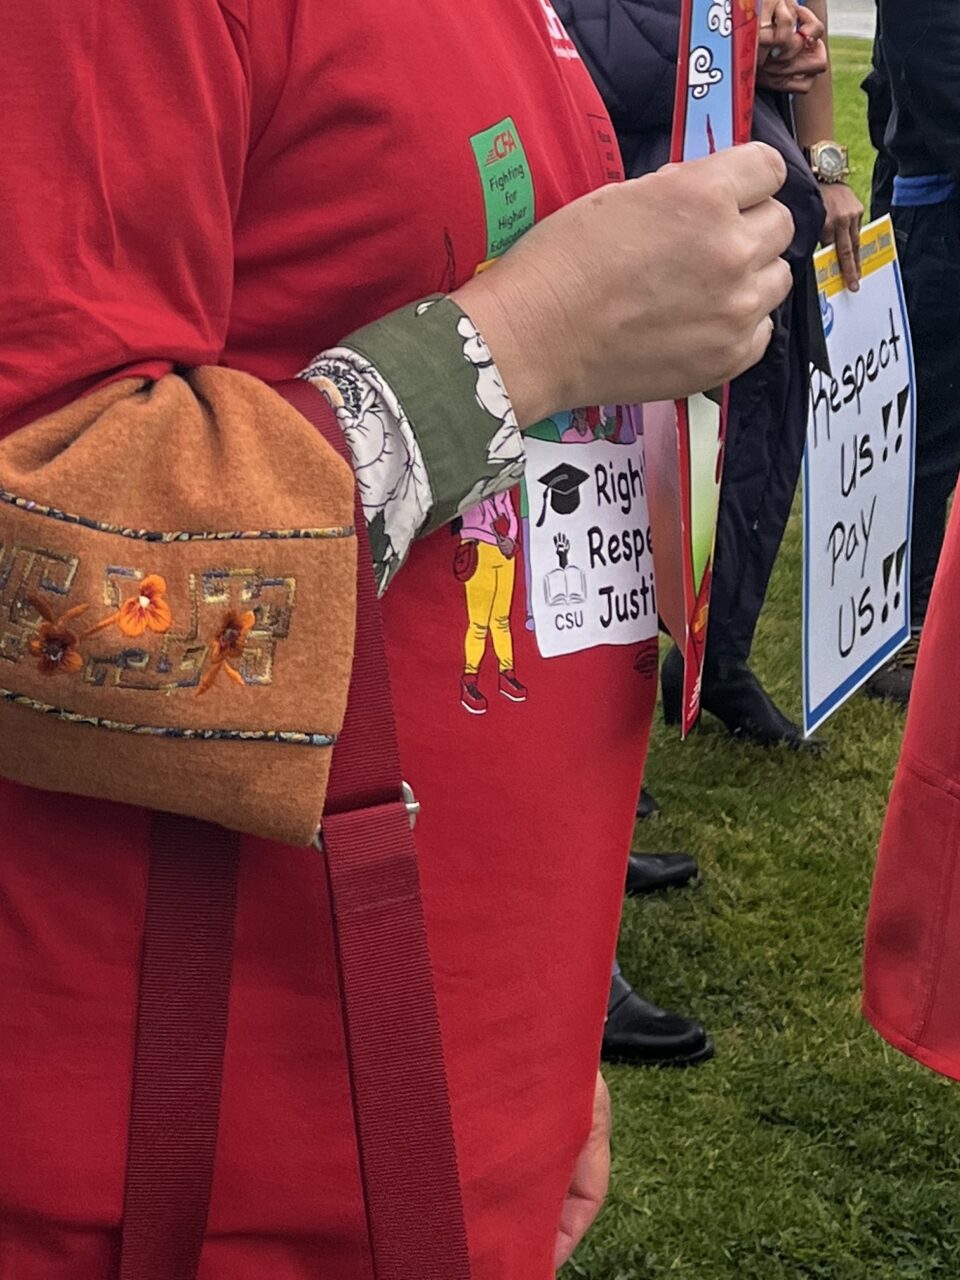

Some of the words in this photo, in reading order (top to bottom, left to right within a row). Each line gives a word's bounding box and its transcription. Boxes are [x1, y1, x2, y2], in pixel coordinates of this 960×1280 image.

[493, 129, 518, 160] CFA
[488, 164, 526, 192] Fighting
[504, 189, 518, 206] for
[497, 205, 528, 231] Higher
[809, 307, 901, 449] Respect
[594, 454, 646, 515] Righ
[554, 610, 585, 632] CSU
